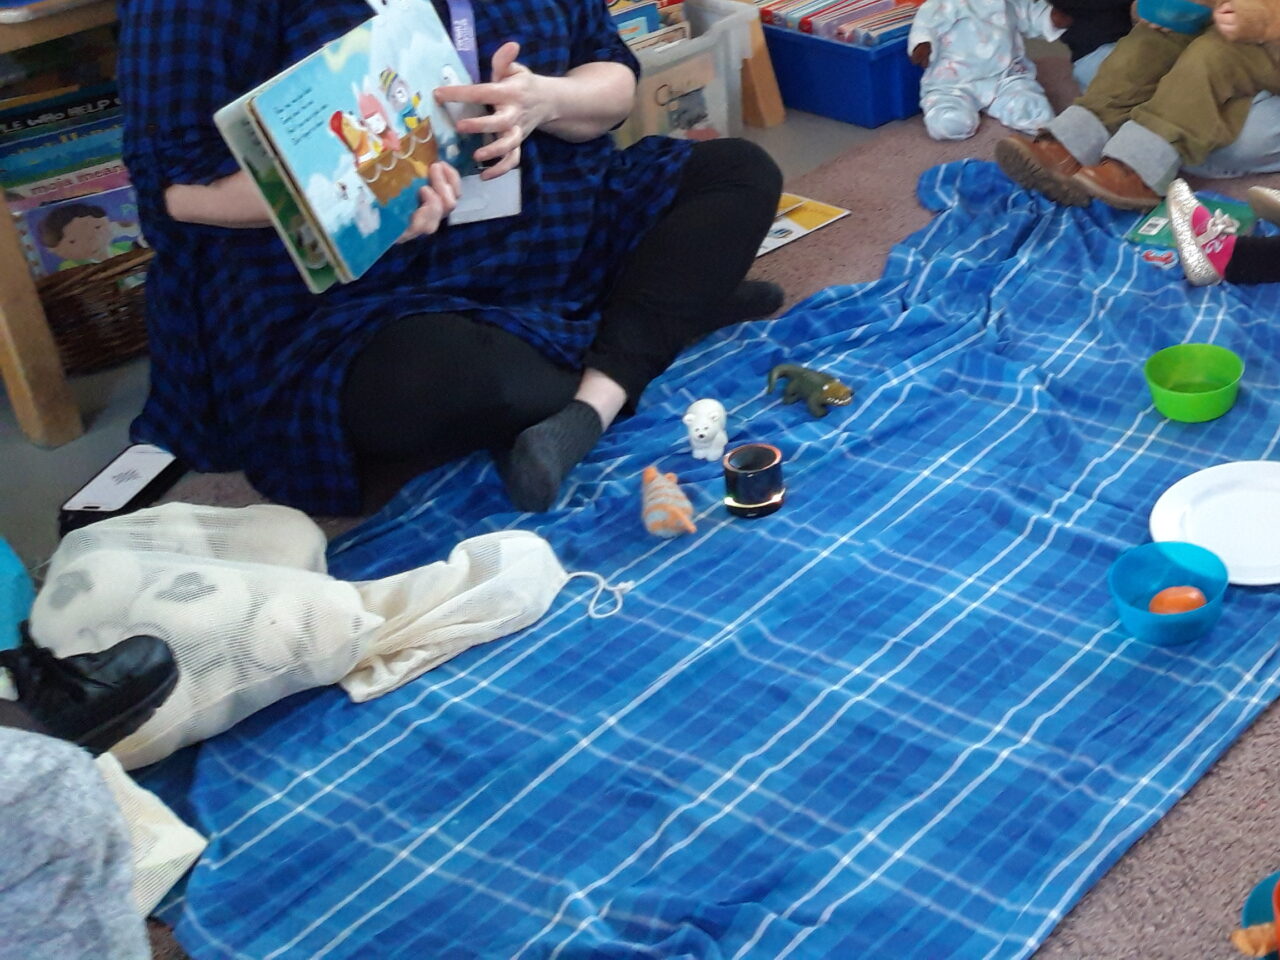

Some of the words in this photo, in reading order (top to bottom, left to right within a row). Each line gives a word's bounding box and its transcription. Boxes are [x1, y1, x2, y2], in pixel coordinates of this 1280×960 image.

[1, 120, 23, 133] LE
[67, 98, 111, 116] HELP
[76, 163, 126, 182] mean
